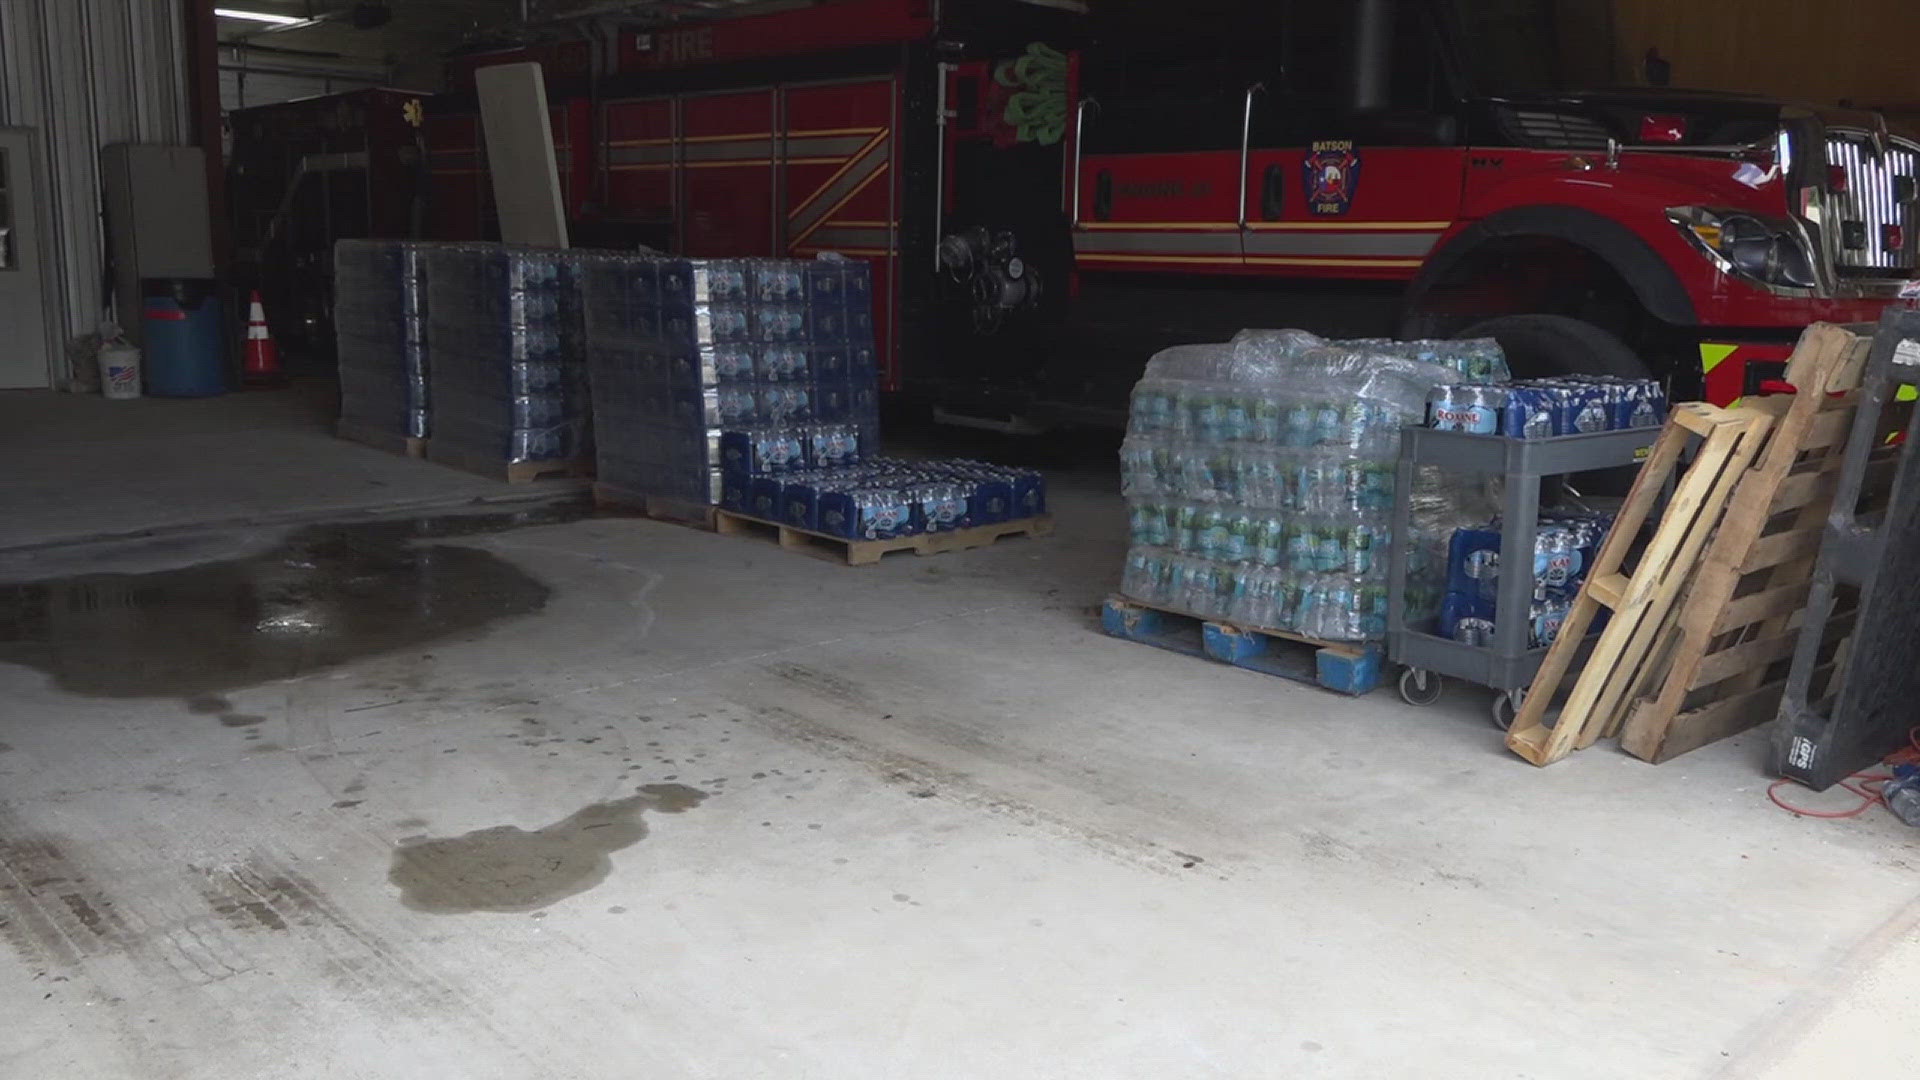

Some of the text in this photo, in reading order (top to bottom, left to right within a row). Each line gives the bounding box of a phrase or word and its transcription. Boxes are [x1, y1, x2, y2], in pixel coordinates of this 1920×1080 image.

[657, 28, 713, 61] FIRE
[1312, 140, 1353, 152] BATSON
[1317, 203, 1340, 214] FIRE
